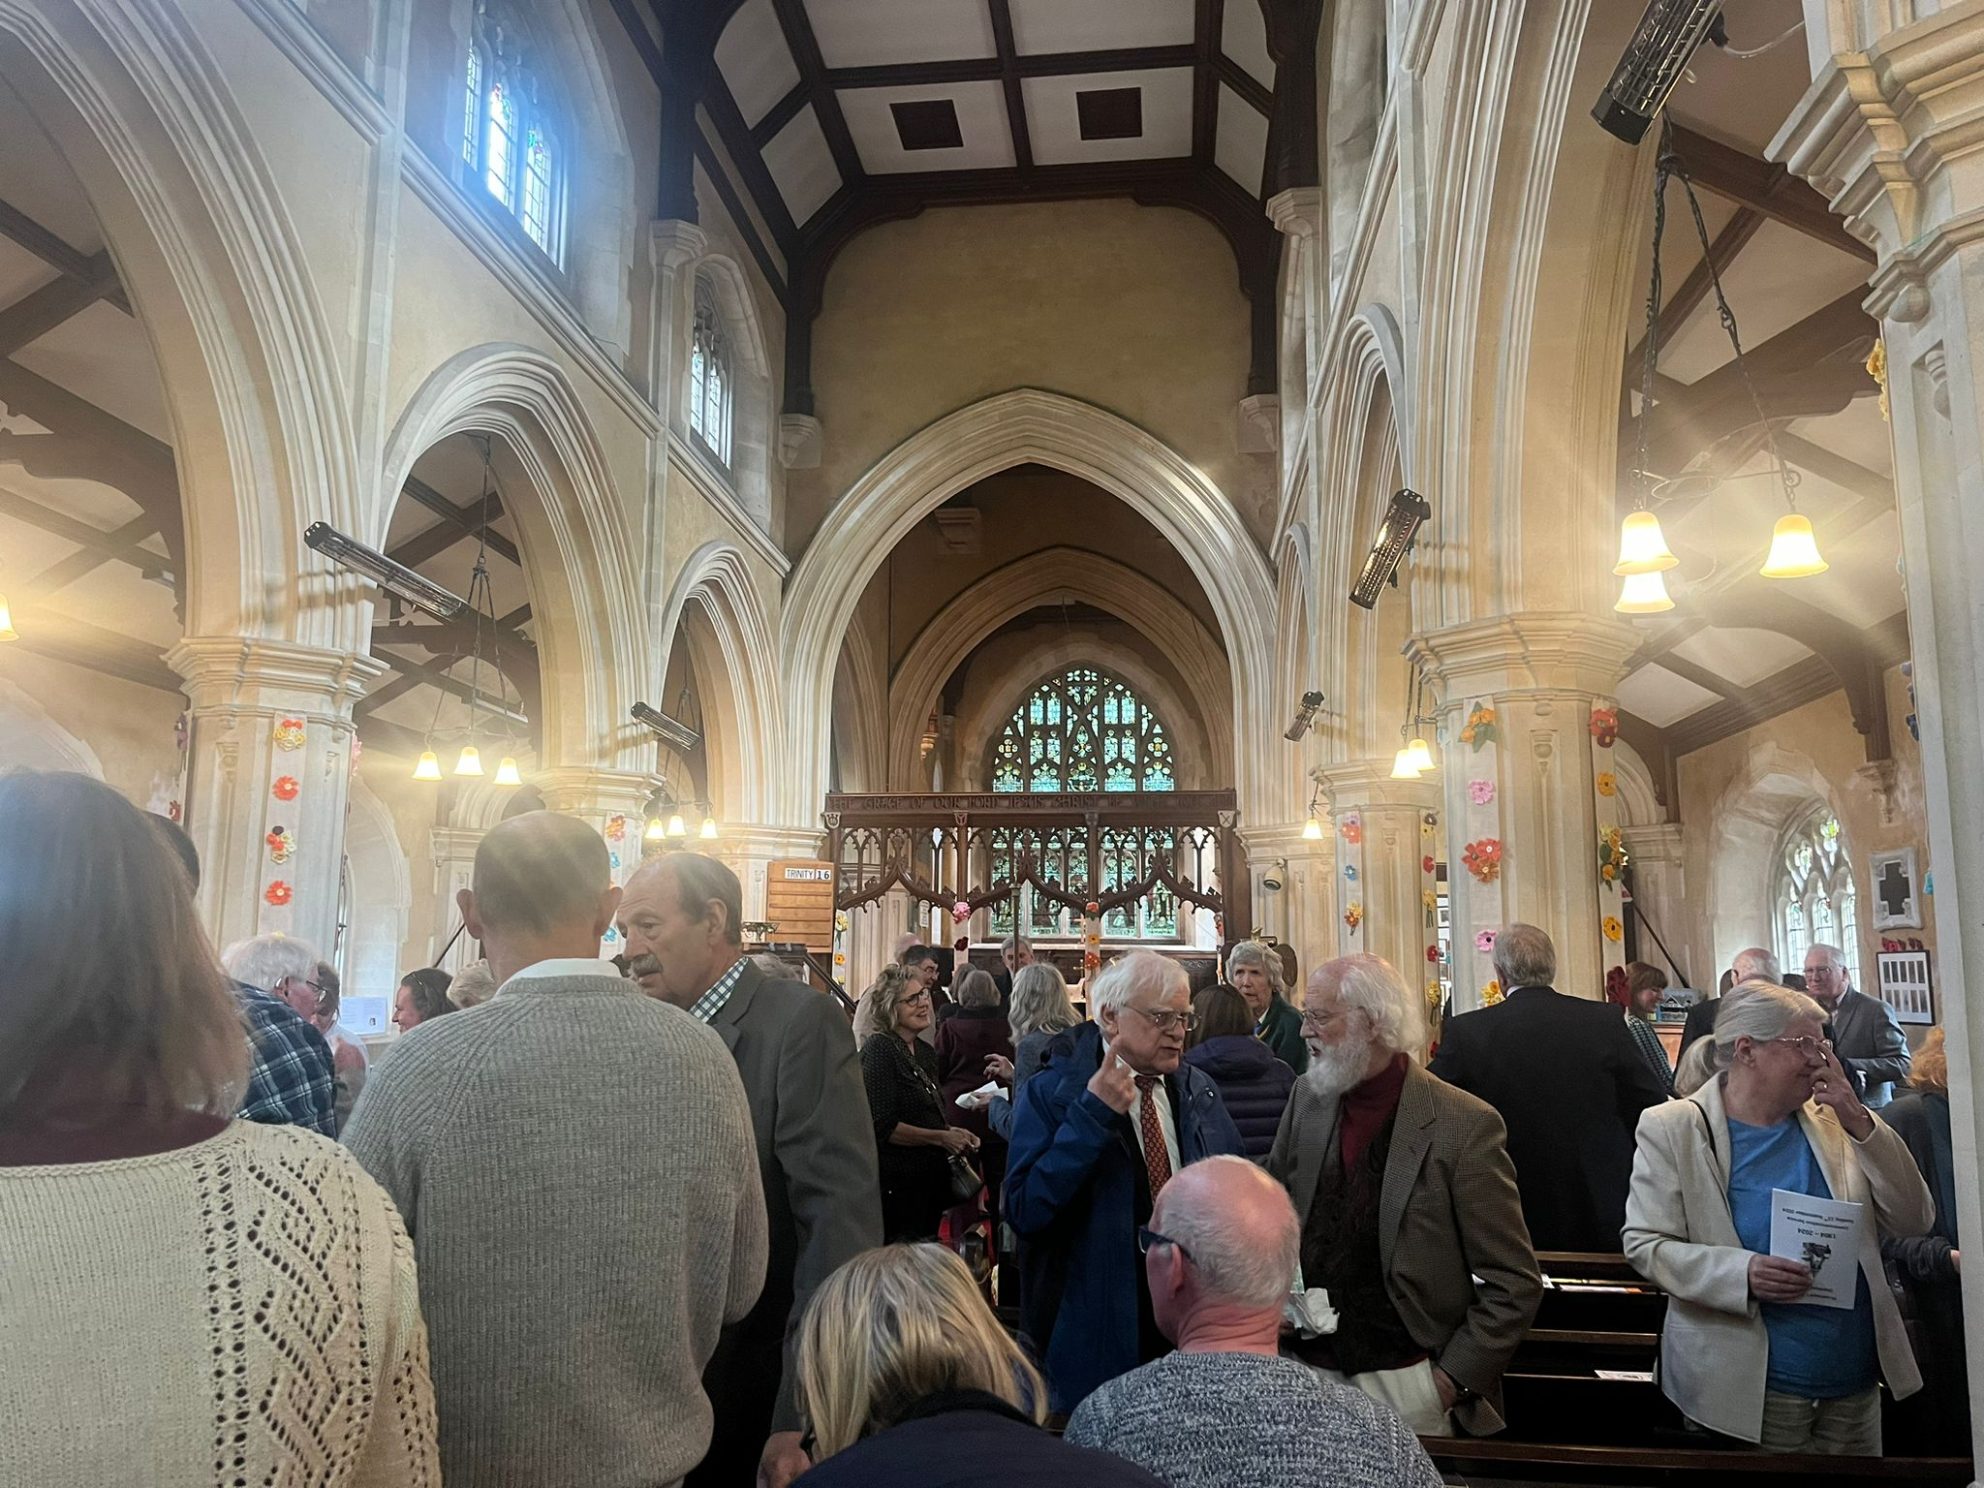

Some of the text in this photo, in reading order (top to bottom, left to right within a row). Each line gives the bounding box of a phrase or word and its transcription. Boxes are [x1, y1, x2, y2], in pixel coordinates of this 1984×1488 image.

[863, 797, 903, 809] GRACE
[911, 796, 927, 809] OF
[933, 796, 962, 809] OUR
[969, 796, 999, 808] LORD
[787, 869, 830, 880] TRINITY 16
[1798, 1228, 1813, 1236] 2024
